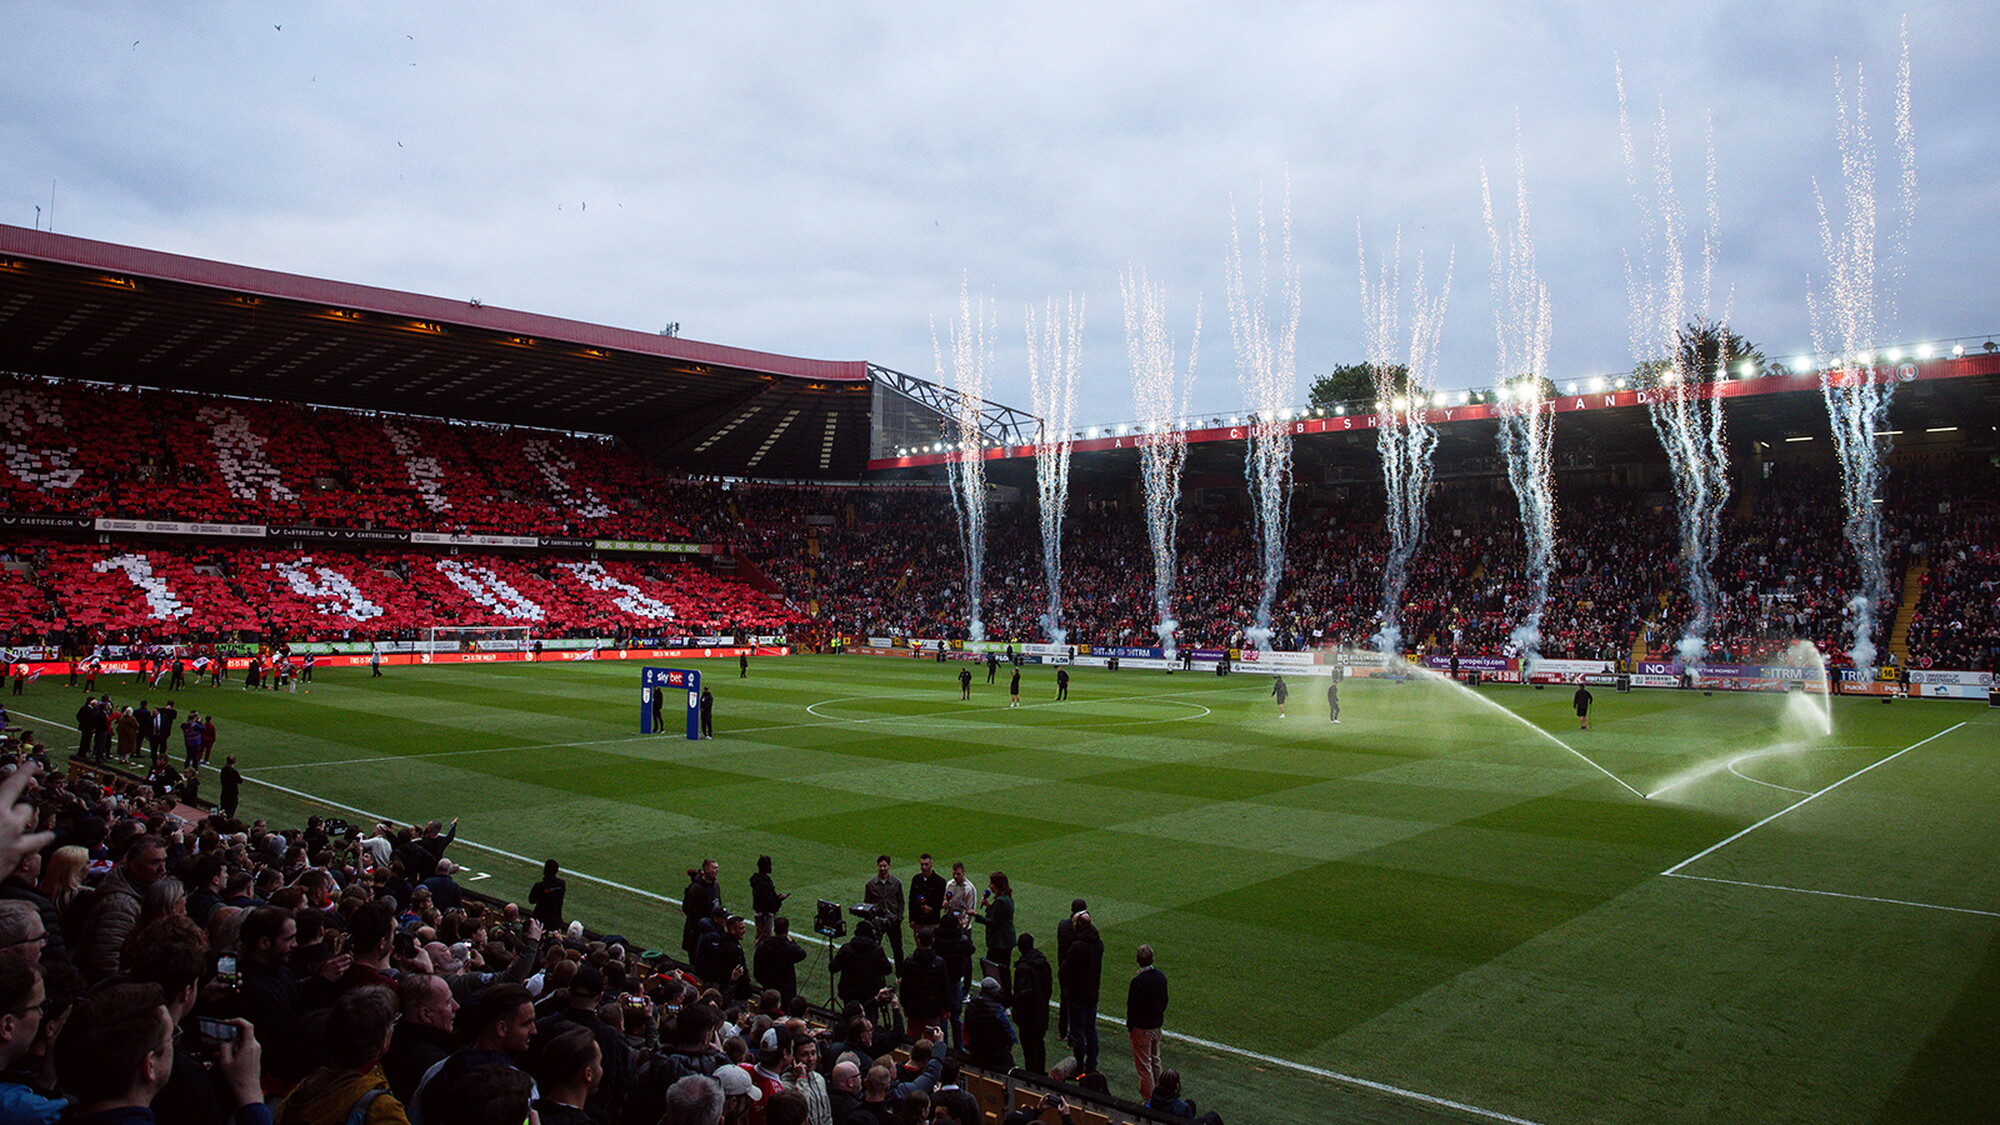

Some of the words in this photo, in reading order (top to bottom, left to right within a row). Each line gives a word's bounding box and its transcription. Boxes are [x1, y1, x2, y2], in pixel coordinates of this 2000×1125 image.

[1115, 433, 1181, 448] ALN
[1230, 410, 1453, 438] CURBISHEY
[1519, 392, 1646, 415] TAND
[20, 518, 74, 526] CASTORE.COM
[1099, 647, 1116, 656] ITM
[1131, 649, 1151, 657] ITRM
[1432, 656, 1506, 666] changgproperty.com
[657, 671, 669, 684] sky
[669, 672, 683, 683] bet
[1771, 668, 1802, 679] ITRM
[1840, 670, 1870, 681] TRM
